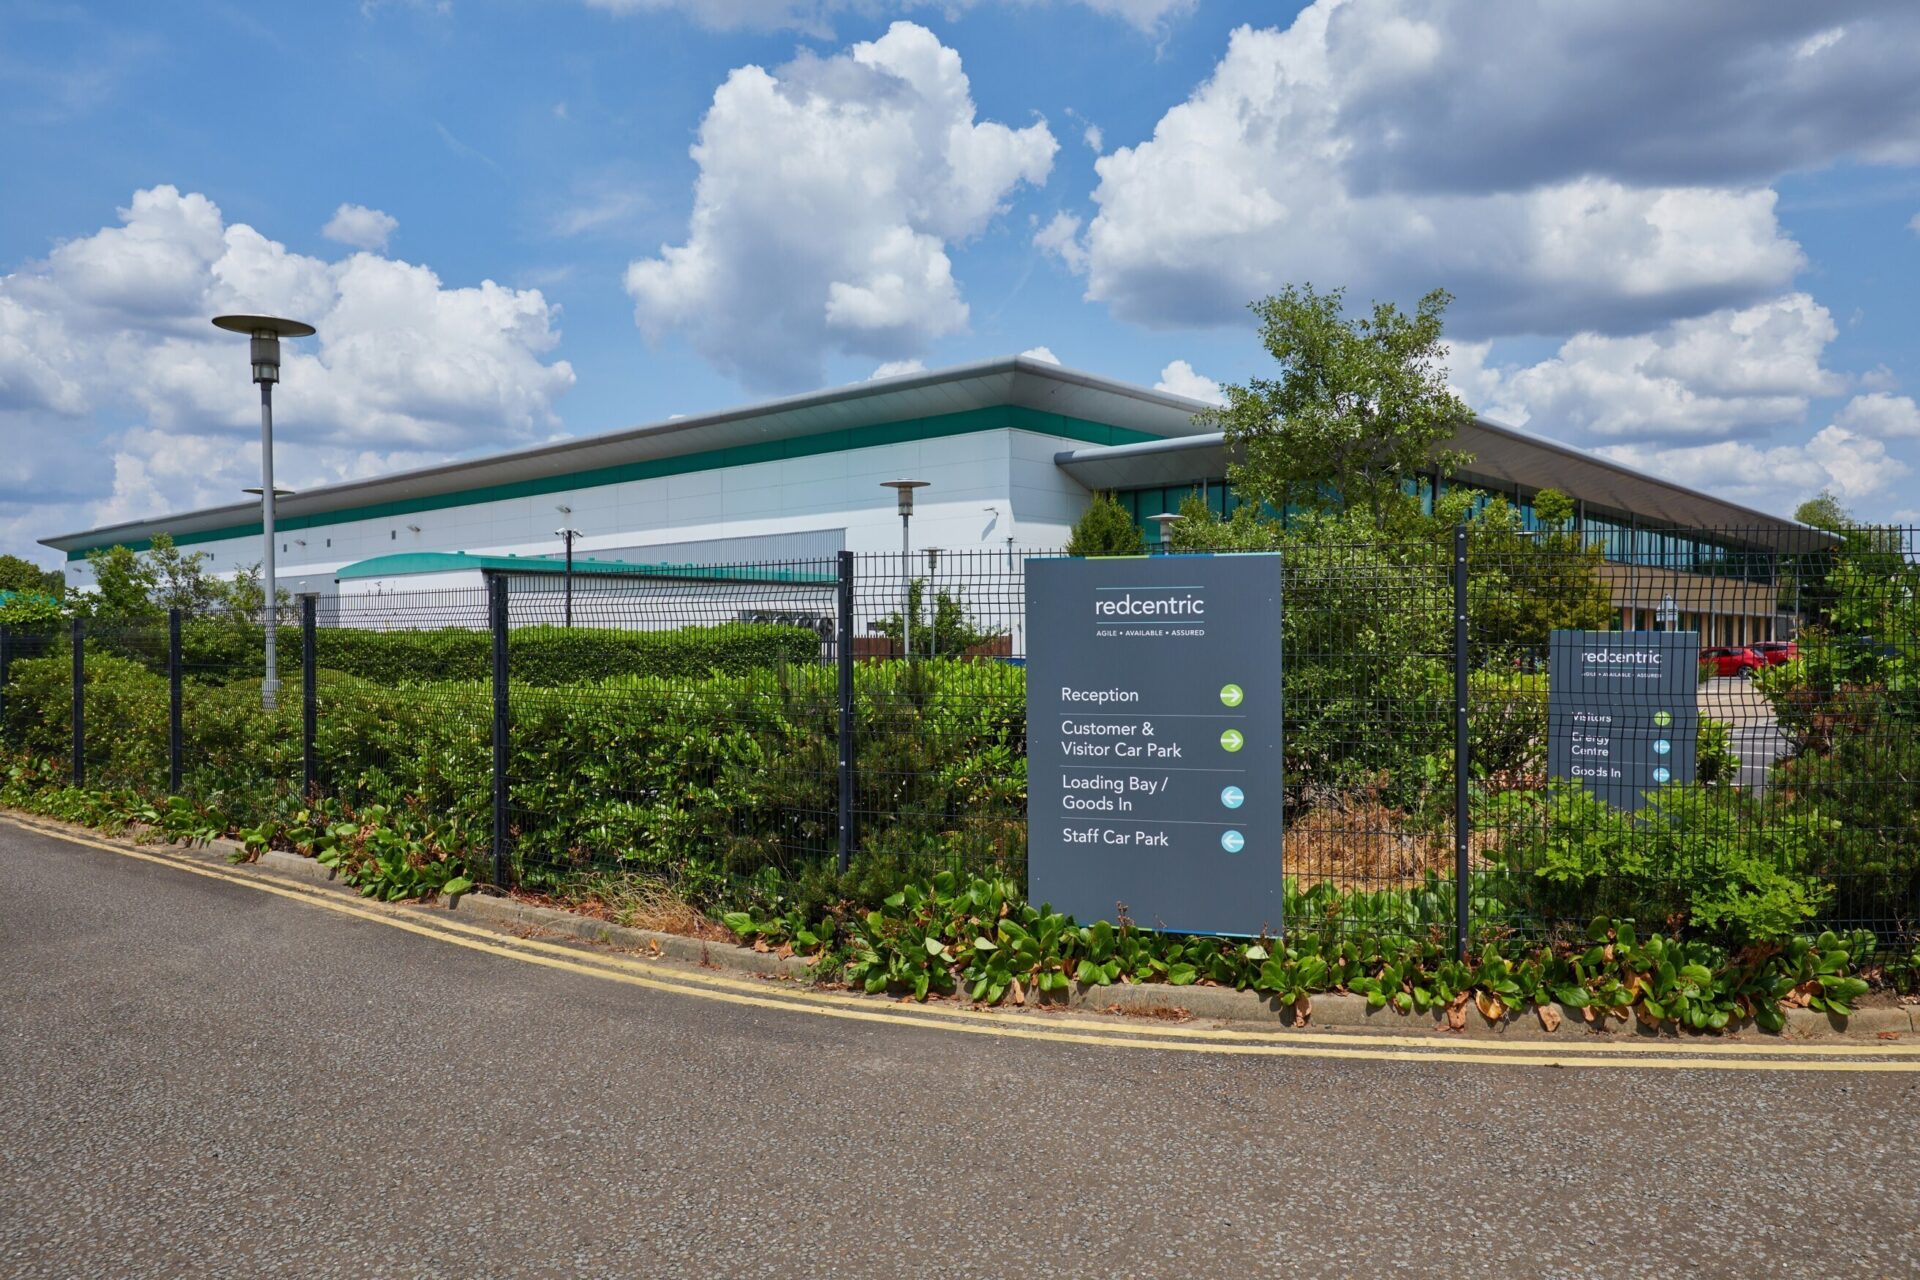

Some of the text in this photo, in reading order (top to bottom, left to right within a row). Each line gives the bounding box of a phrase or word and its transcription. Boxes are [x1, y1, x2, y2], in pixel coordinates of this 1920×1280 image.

[1096, 594, 1204, 615] redcentric
[1581, 648, 1662, 664] redcentric
[1061, 687, 1139, 705] Reception
[1061, 720, 1154, 736] Customer &
[1061, 741, 1182, 758] Visitor Car Park
[1571, 745, 1609, 757] Centre
[1571, 765, 1621, 778] Goods In
[1062, 774, 1124, 794] Loading
[1129, 777, 1158, 795] Bay
[1062, 795, 1132, 811] Goods In
[1063, 828, 1169, 847] Staff Car Park
